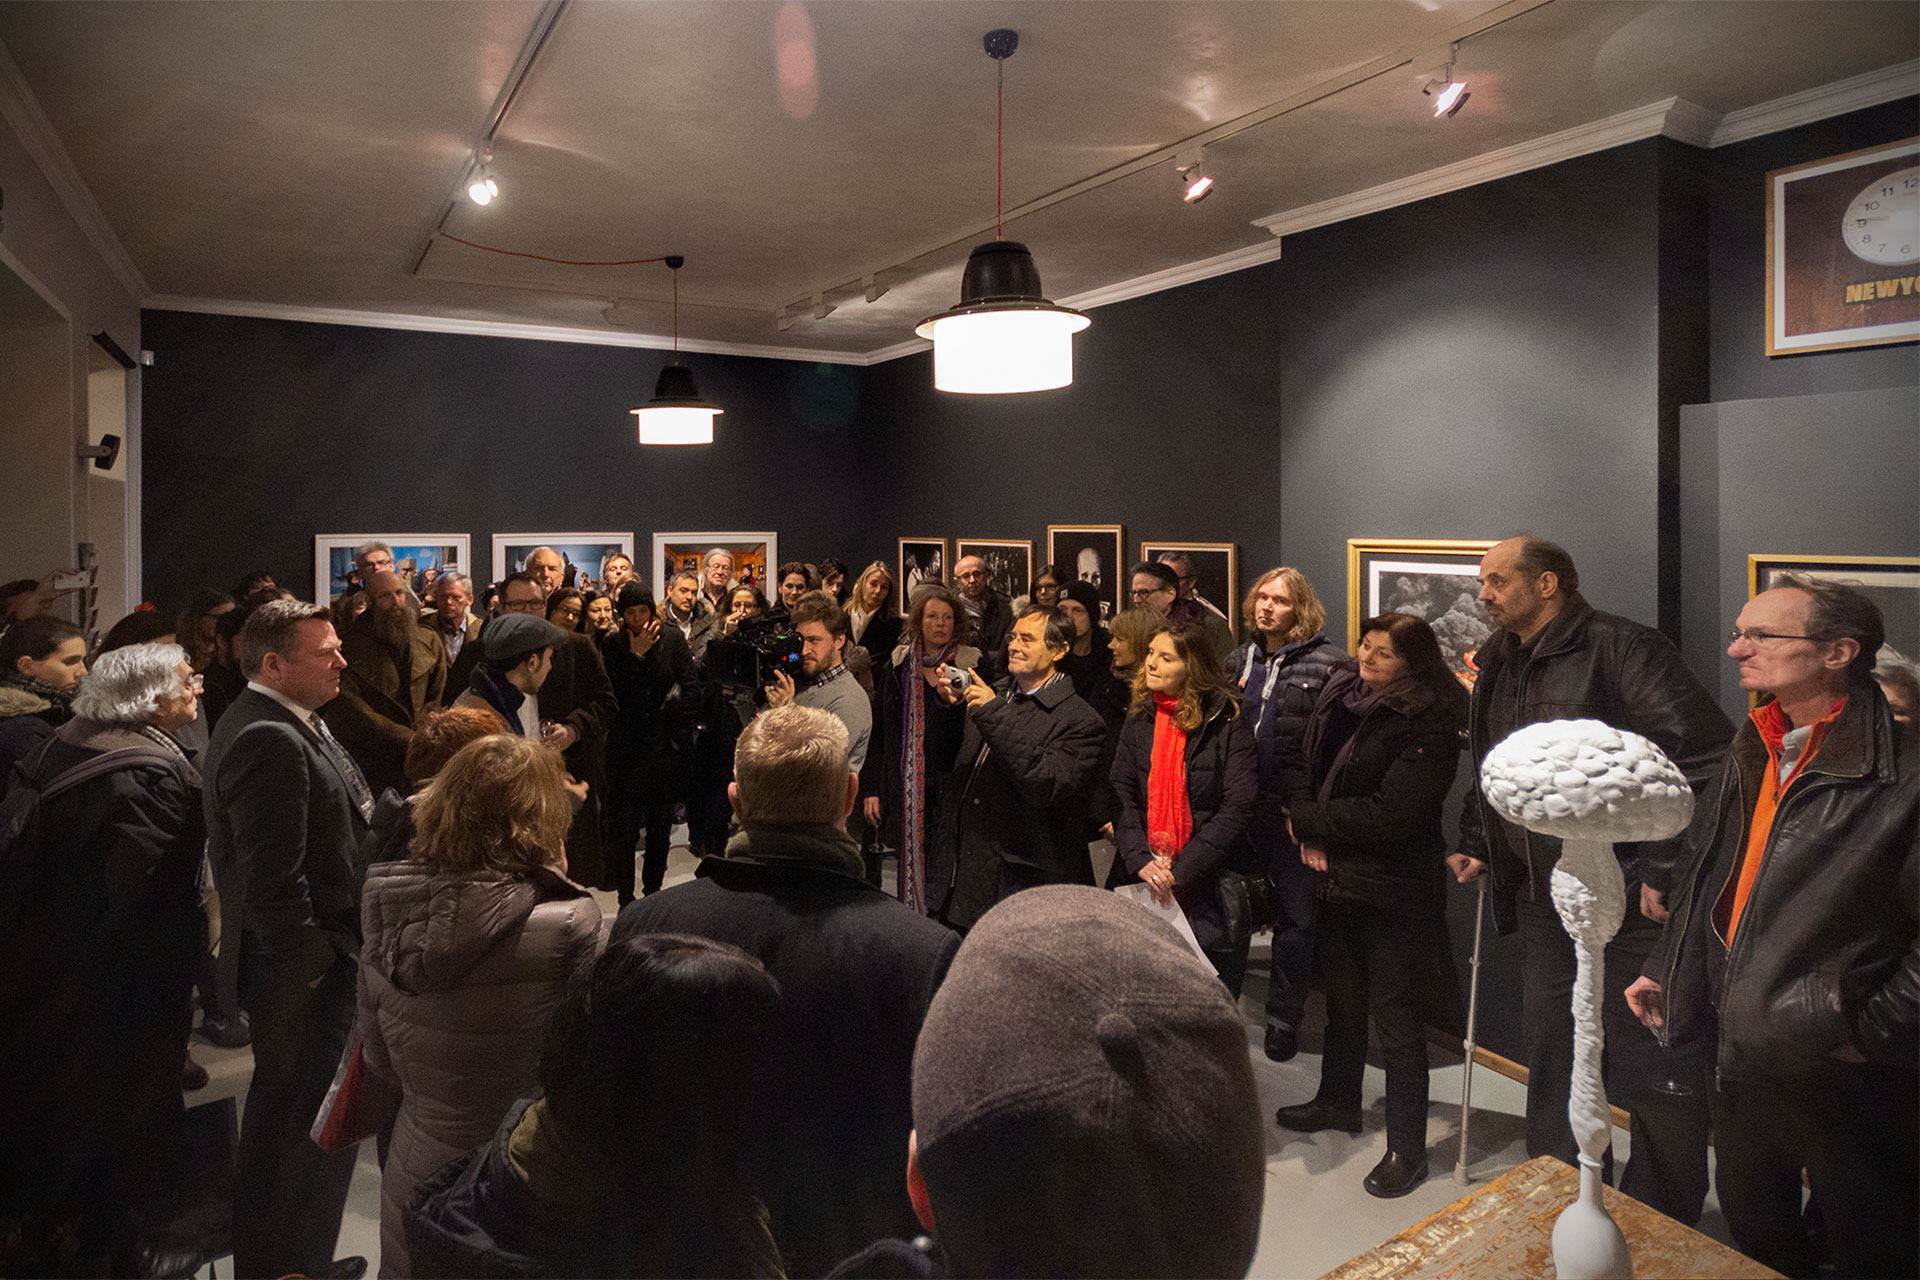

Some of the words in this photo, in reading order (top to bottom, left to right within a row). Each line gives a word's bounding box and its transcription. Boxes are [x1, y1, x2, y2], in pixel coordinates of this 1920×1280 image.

[1903, 178, 1920, 189] 12
[1881, 187, 1894, 197] 11
[1864, 201, 1880, 211] 10
[1862, 234, 1872, 244] 8
[1879, 243, 1887, 253] 7
[1900, 244, 1911, 254] 6
